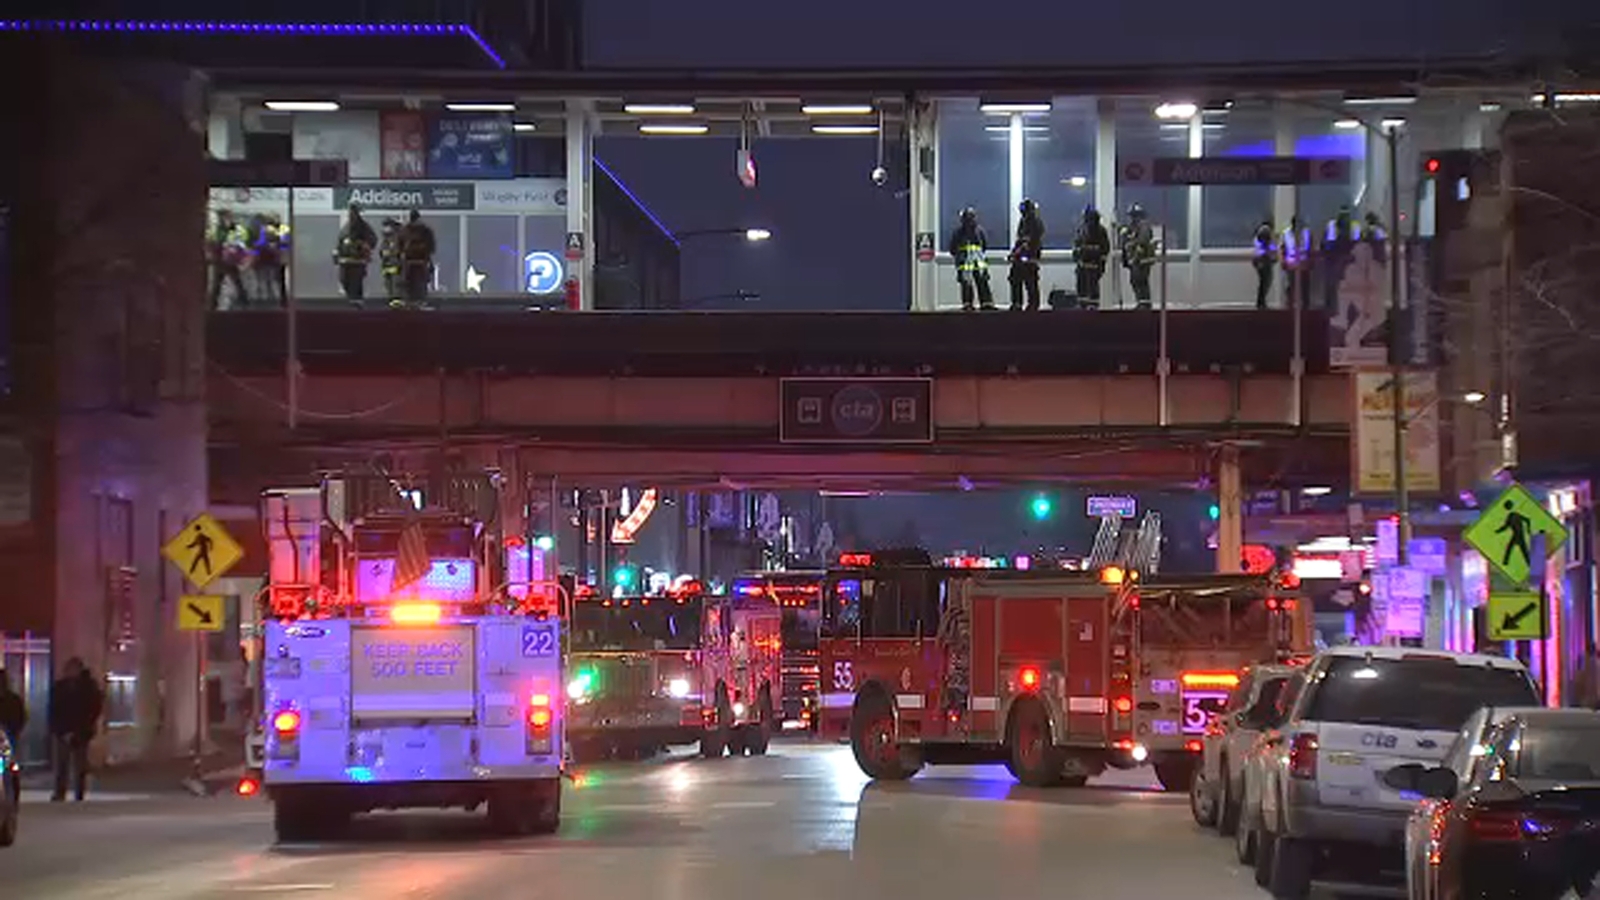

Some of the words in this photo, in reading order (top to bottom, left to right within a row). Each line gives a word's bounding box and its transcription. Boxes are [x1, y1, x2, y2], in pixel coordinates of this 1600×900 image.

[350, 187, 423, 205] Addison
[839, 400, 874, 418] cta
[364, 643, 410, 658] KEEP
[417, 642, 464, 658] BACK
[524, 632, 553, 655] 22
[372, 661, 406, 677] 500
[415, 660, 459, 676] FEET
[833, 661, 853, 689] 55
[1361, 730, 1398, 749] cta
